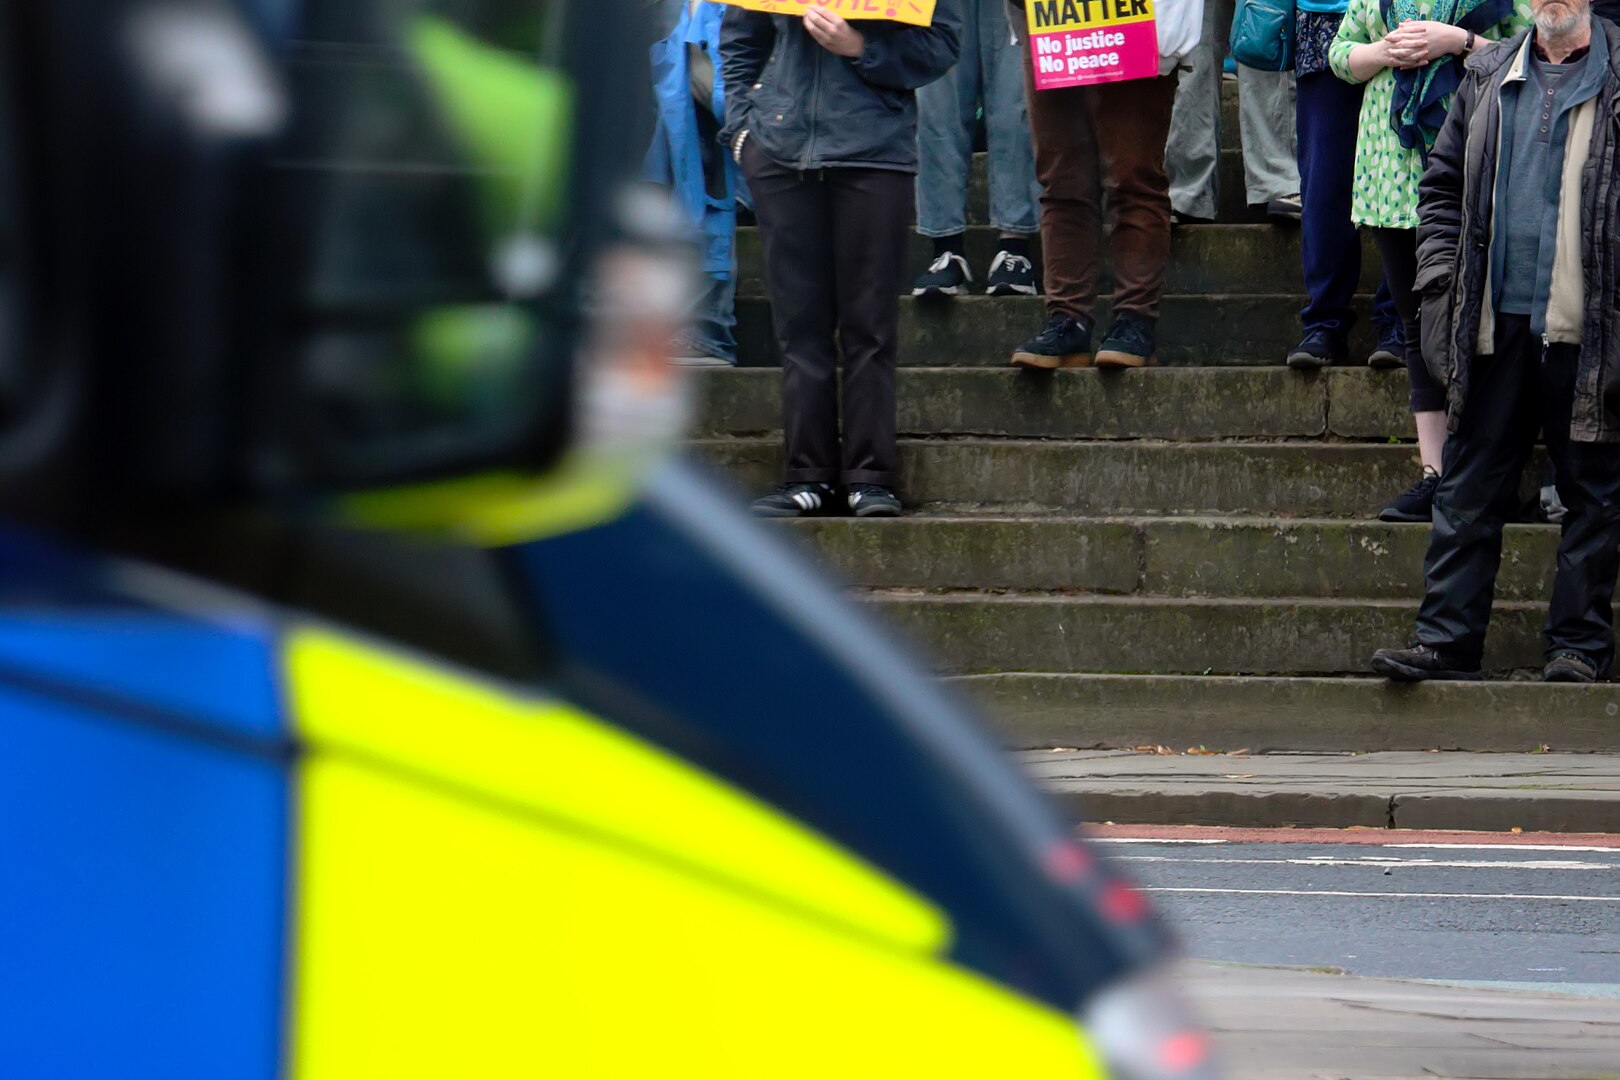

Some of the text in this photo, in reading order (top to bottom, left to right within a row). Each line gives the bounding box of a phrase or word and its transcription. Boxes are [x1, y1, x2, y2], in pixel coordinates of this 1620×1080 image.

[1037, 30, 1125, 56] No justice
[1039, 52, 1119, 74] No peace
